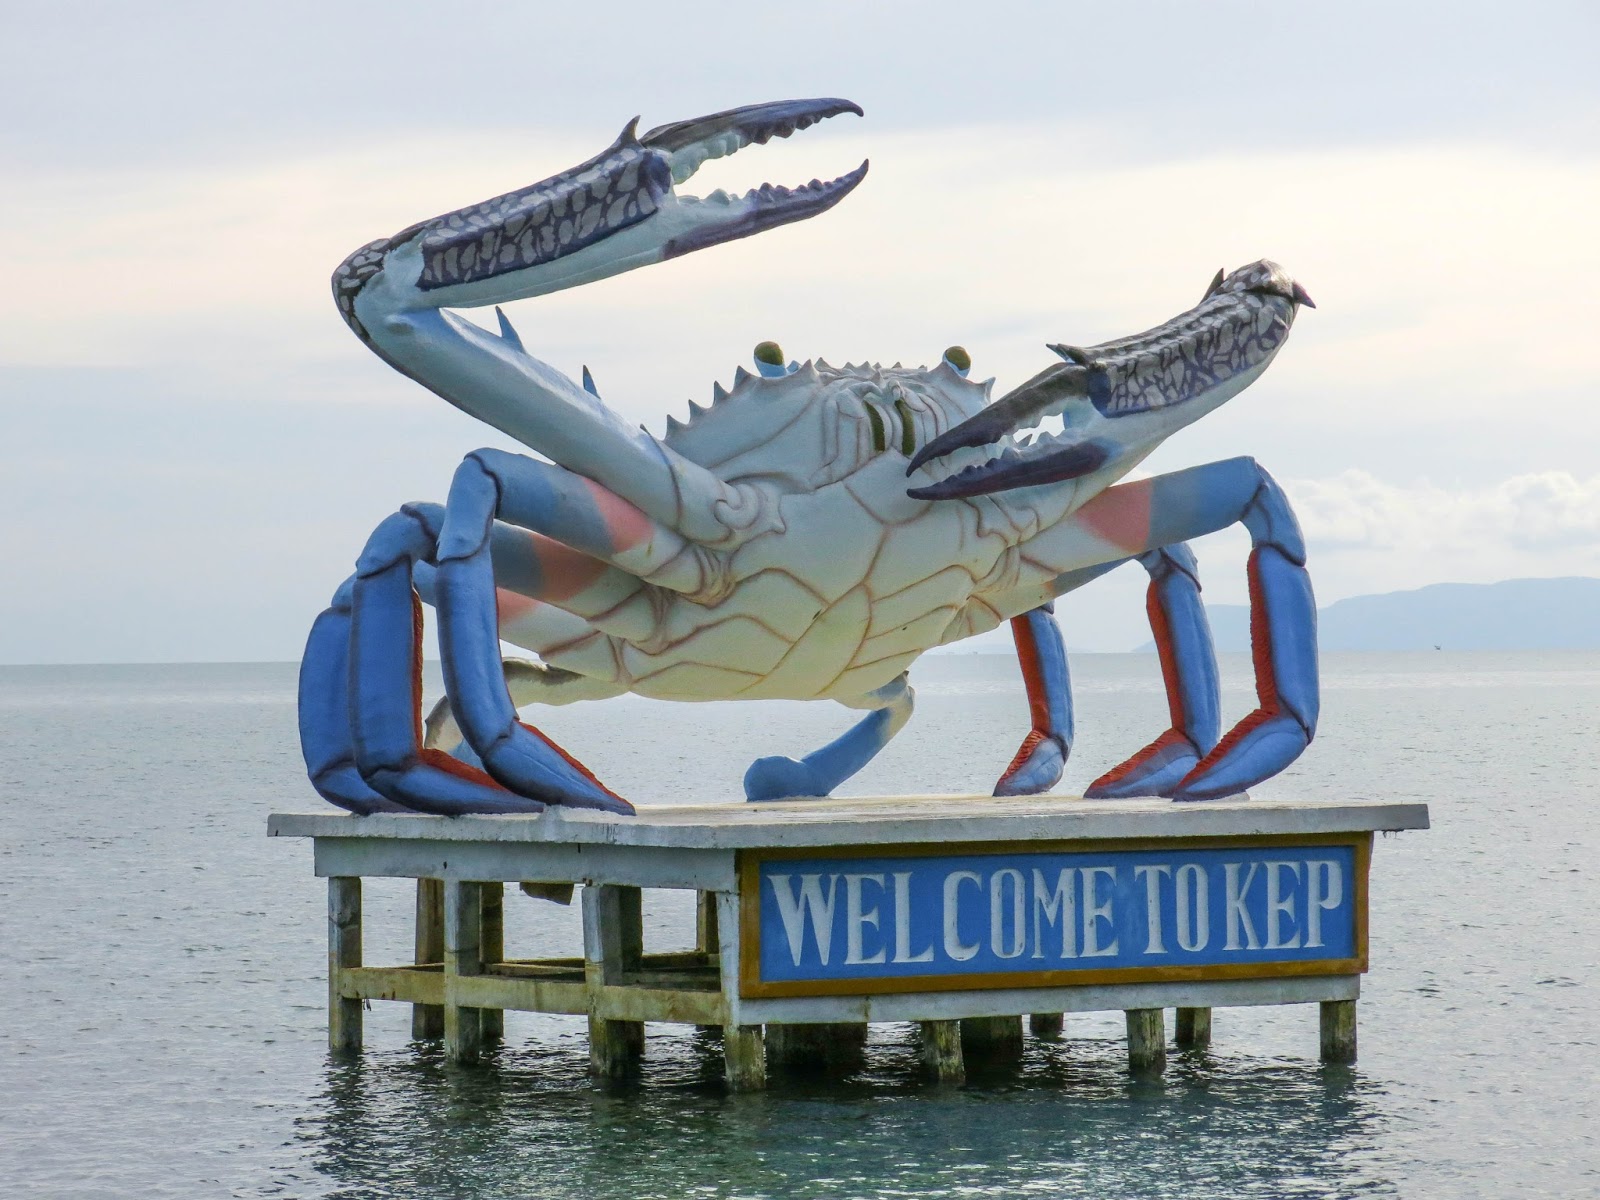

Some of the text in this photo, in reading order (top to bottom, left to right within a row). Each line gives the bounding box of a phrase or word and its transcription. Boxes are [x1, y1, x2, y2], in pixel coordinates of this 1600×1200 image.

[767, 860, 1343, 966] WELCOME TO KEP
